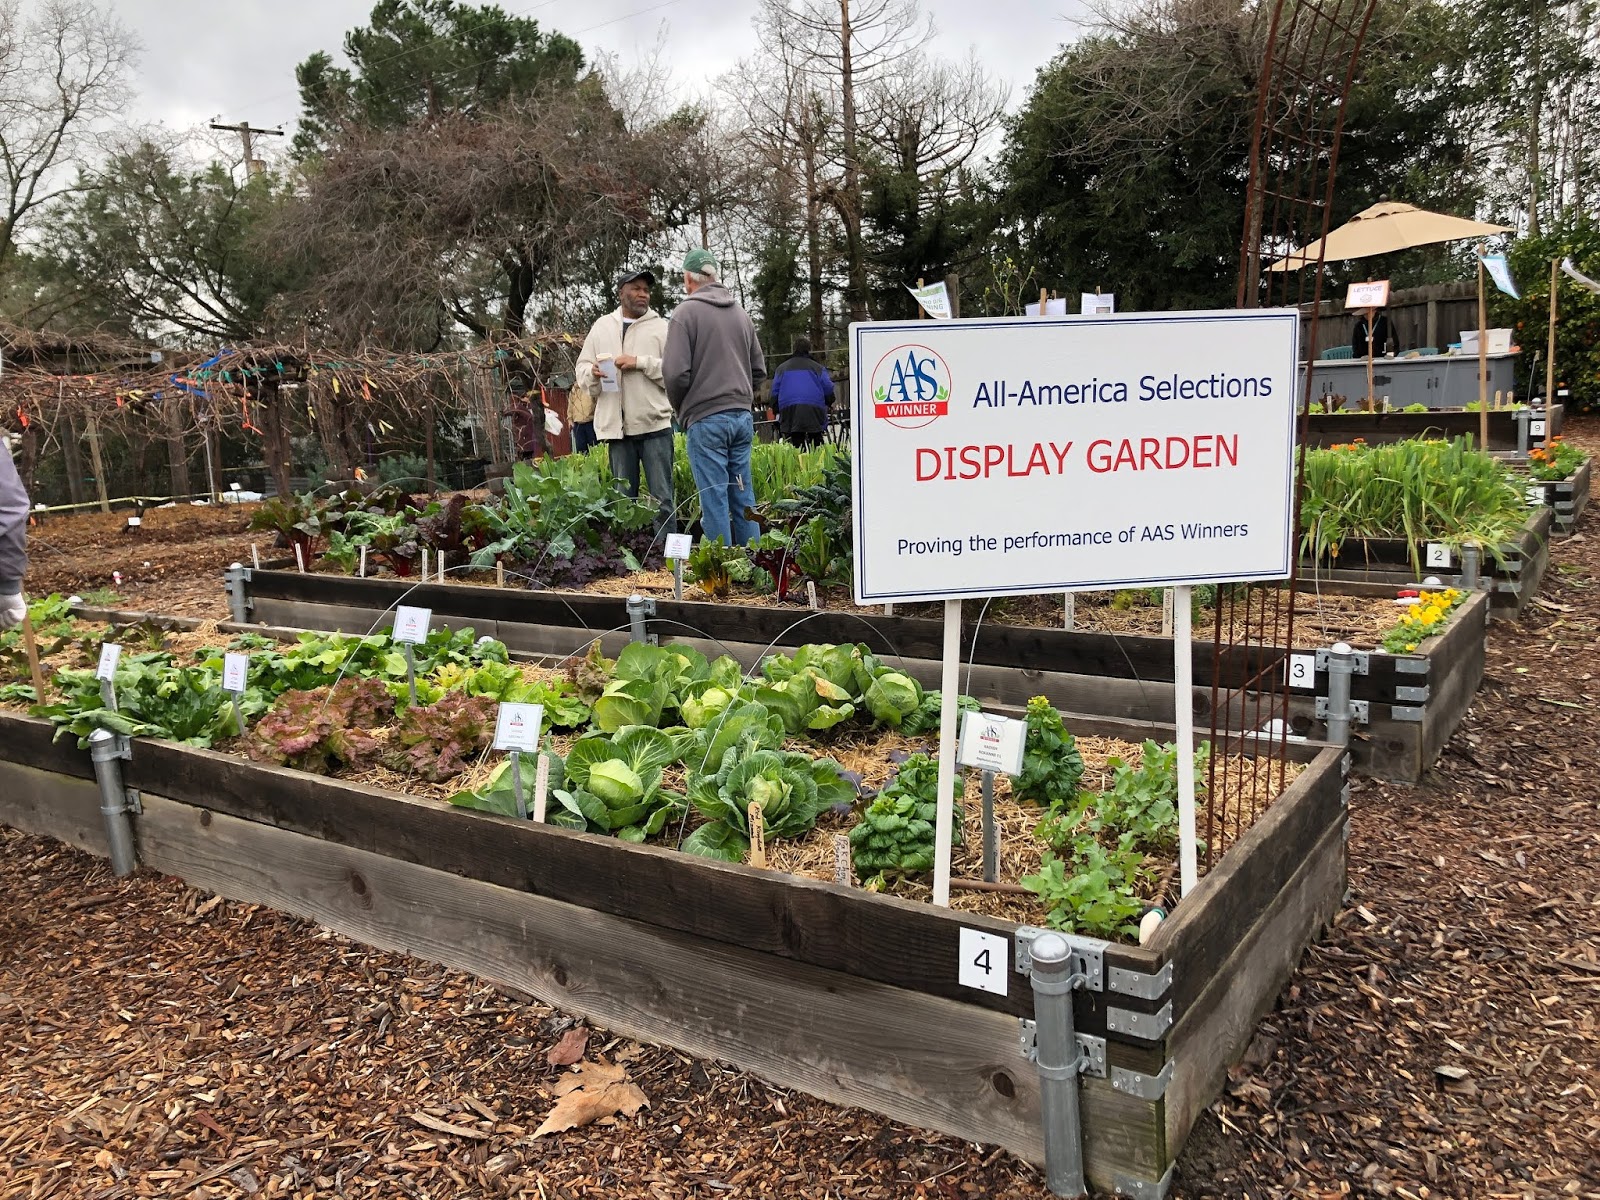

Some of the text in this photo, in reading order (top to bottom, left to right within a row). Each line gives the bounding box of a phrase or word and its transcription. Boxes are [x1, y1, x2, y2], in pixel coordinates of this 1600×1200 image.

[1353, 285, 1382, 293] LETTUCE
[884, 350, 938, 402] AAS
[972, 372, 1272, 408] All-America Selections
[886, 403, 937, 416] WINNER
[1534, 424, 1541, 432] 9
[915, 434, 1239, 482] DISPLAY GARDEN
[898, 523, 1249, 556] Proving the performance of AAS Winners
[1434, 550, 1443, 561] 2
[1293, 663, 1305, 679] 3
[973, 948, 993, 976] 4
